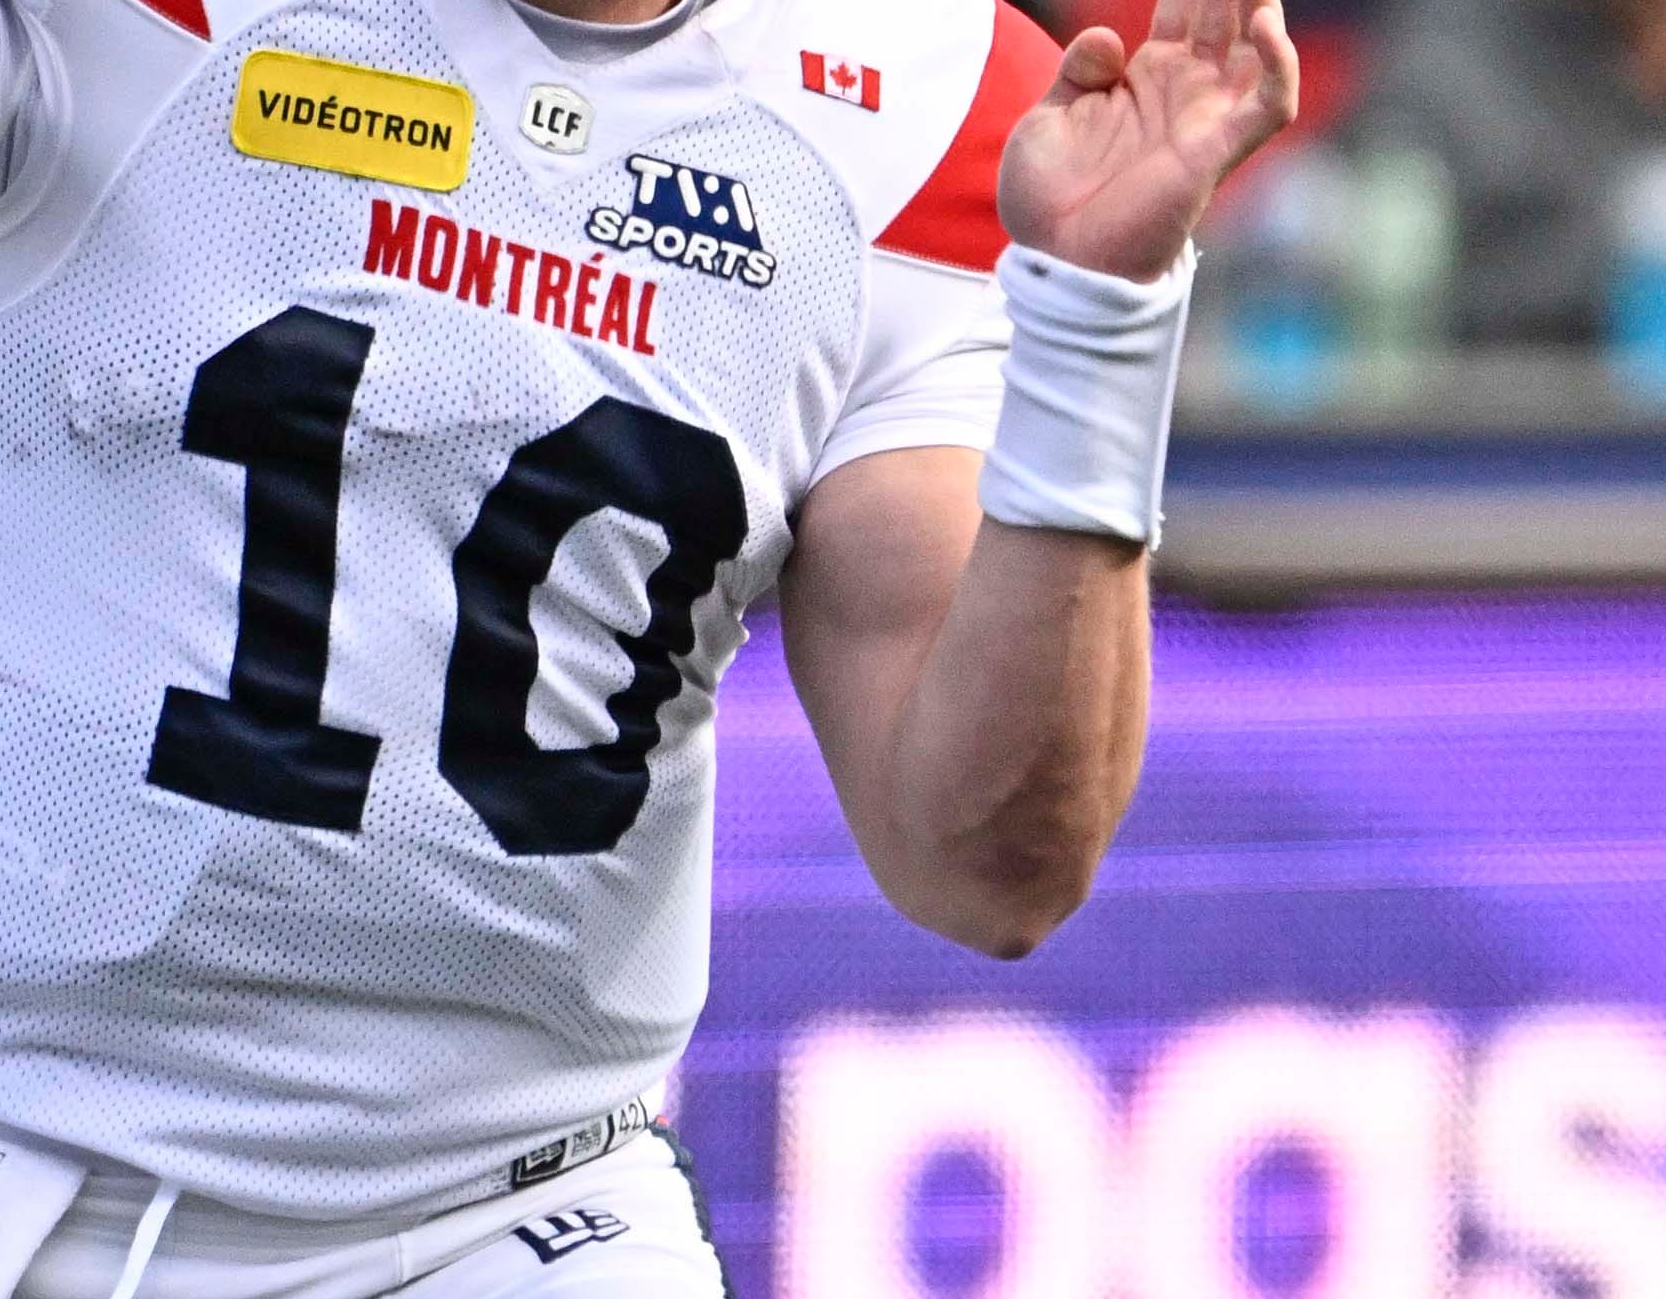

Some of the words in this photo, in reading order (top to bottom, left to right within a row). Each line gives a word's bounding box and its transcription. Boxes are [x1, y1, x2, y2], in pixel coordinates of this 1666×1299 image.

[257, 88, 453, 153] VIDÉOTRON
[530, 99, 583, 140] LCF
[362, 199, 660, 357] MONTRÉAL
[587, 208, 774, 286] SPORTS
[145, 304, 749, 857] 10
